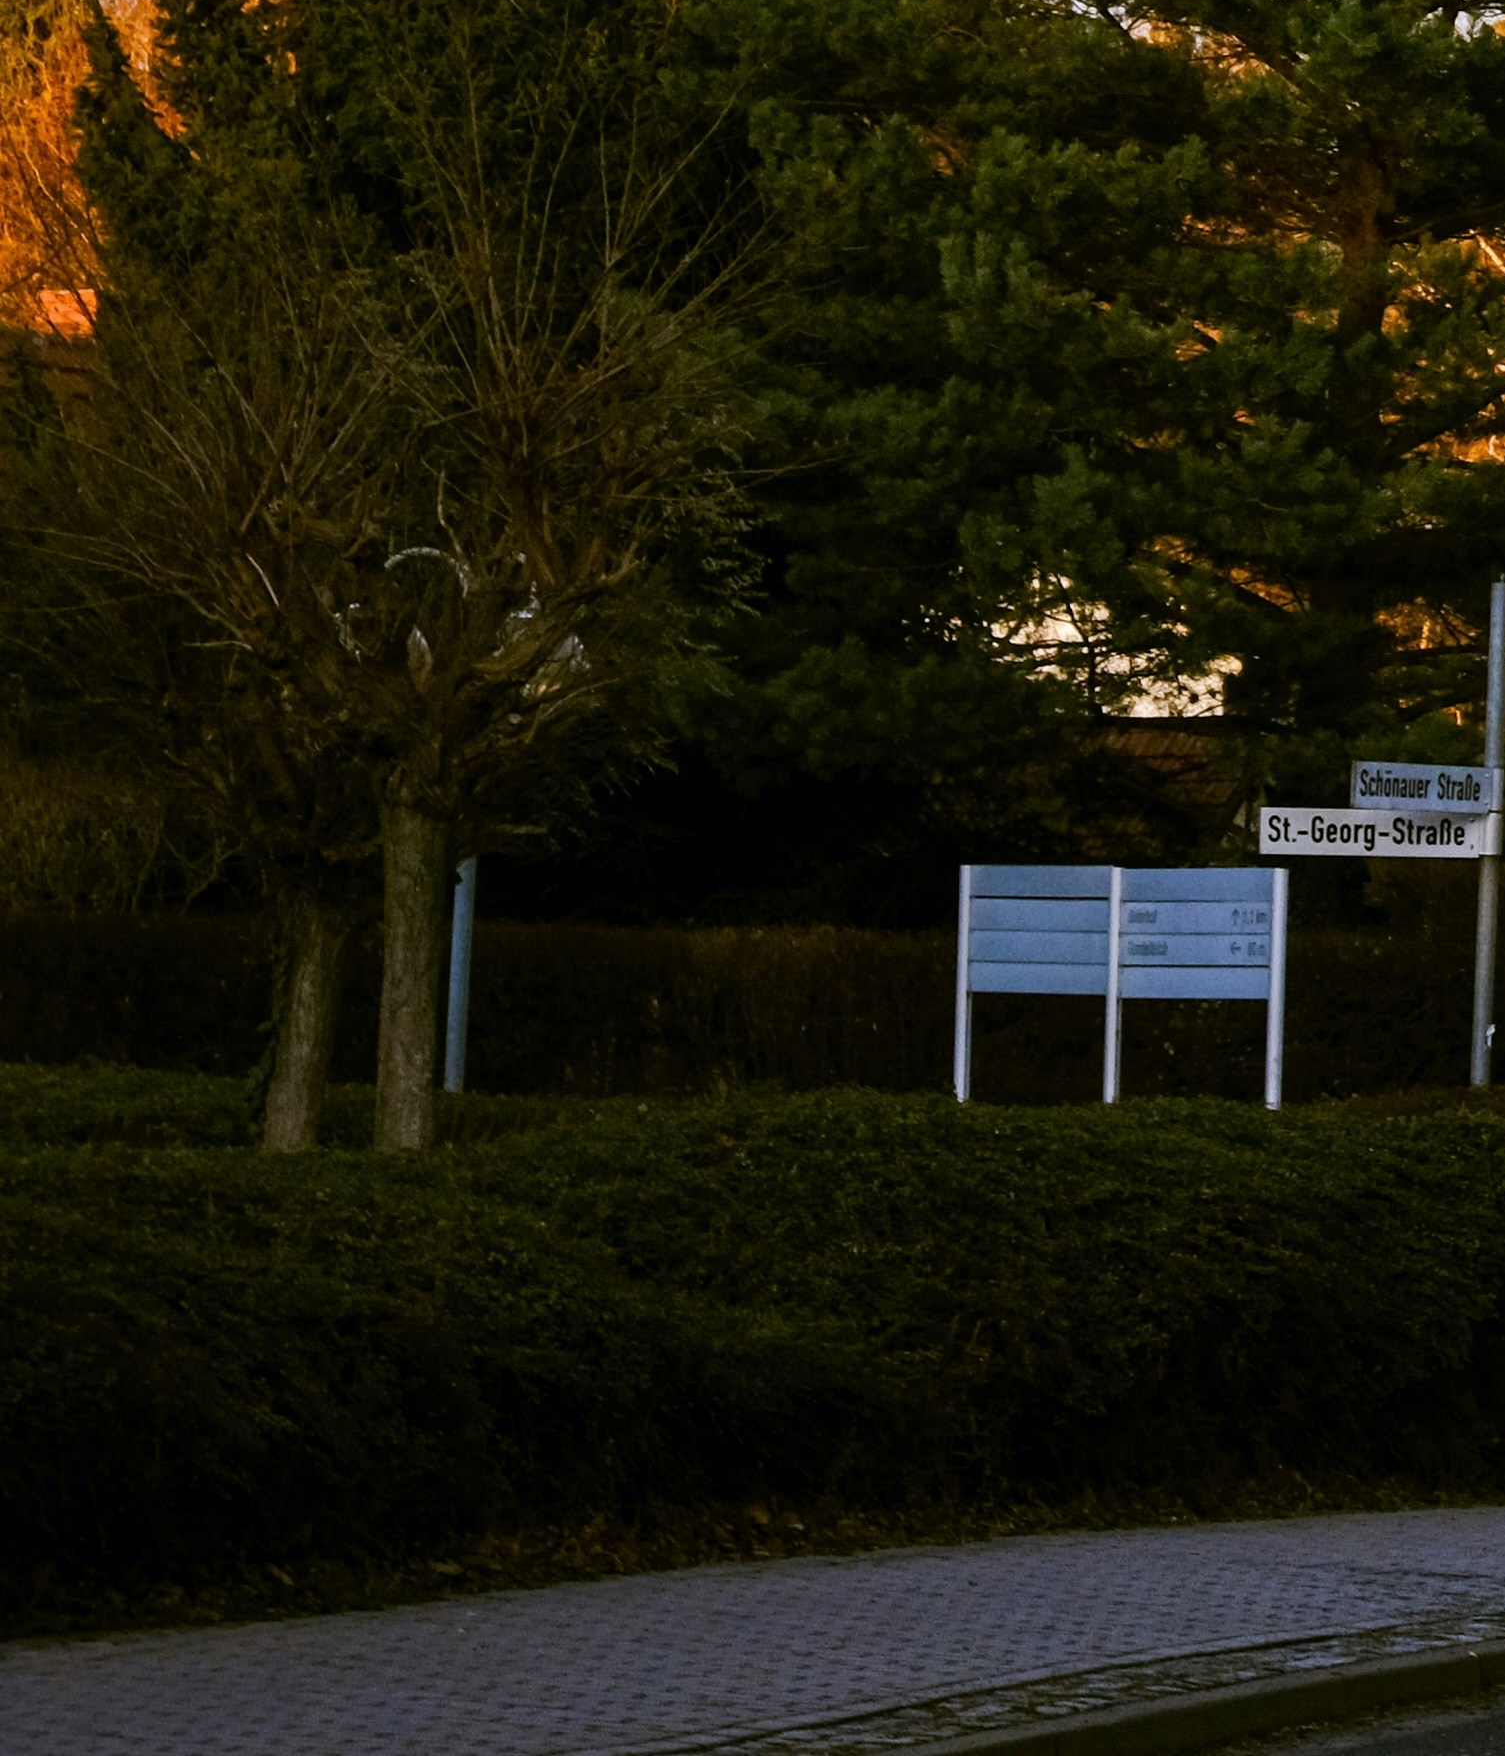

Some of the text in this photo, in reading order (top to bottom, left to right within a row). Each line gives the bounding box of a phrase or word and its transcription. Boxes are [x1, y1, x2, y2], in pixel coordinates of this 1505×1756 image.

[1360, 769, 1481, 802] Schönauer Straße
[1267, 814, 1466, 852] St.-Georg-Straße
